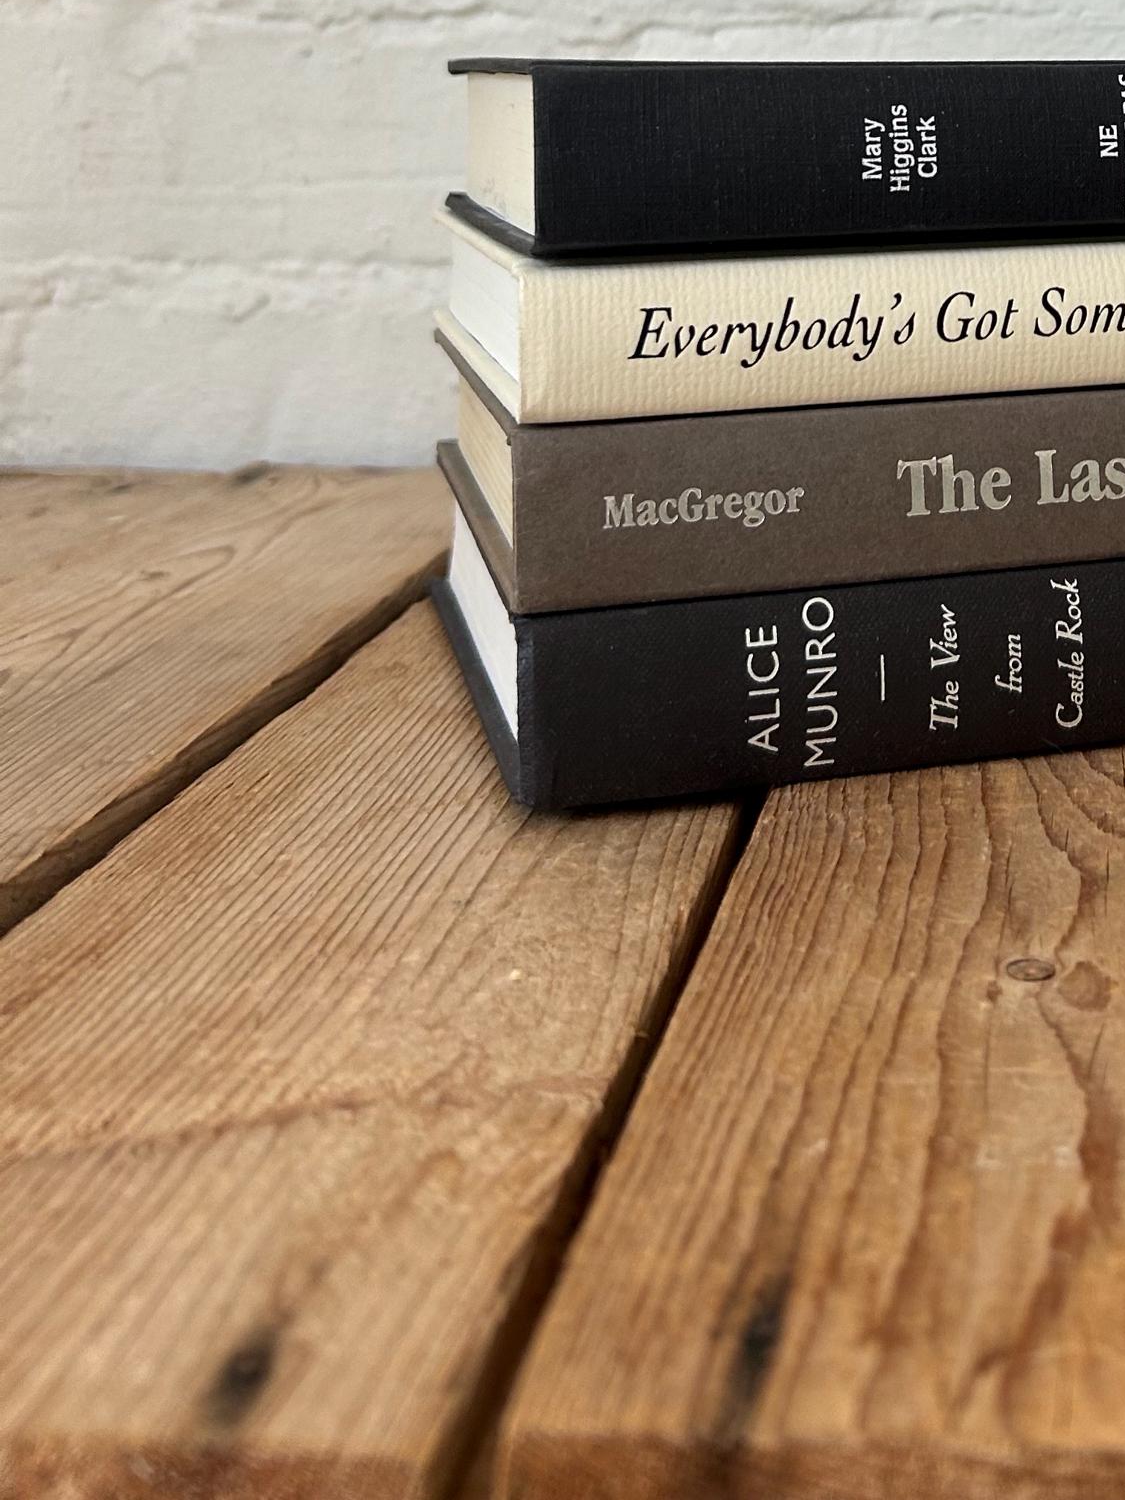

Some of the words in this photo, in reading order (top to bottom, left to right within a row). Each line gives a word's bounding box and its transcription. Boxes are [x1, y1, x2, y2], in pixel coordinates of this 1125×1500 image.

[862, 117, 885, 180] Mary
[889, 104, 914, 192] Higgins
[916, 115, 938, 178] Clark
[1099, 124, 1118, 158] NE
[628, 292, 916, 368] Everybody's
[936, 291, 1018, 342] Got
[603, 487, 804, 529] MacGregor
[897, 453, 1012, 517] The
[930, 604, 960, 669] View
[1050, 578, 1083, 645] Rock
[745, 625, 781, 752] ALICE
[802, 596, 838, 767] MUNRO
[994, 634, 1023, 693] from
[1056, 651, 1084, 728] Castle
[930, 680, 959, 731] The
